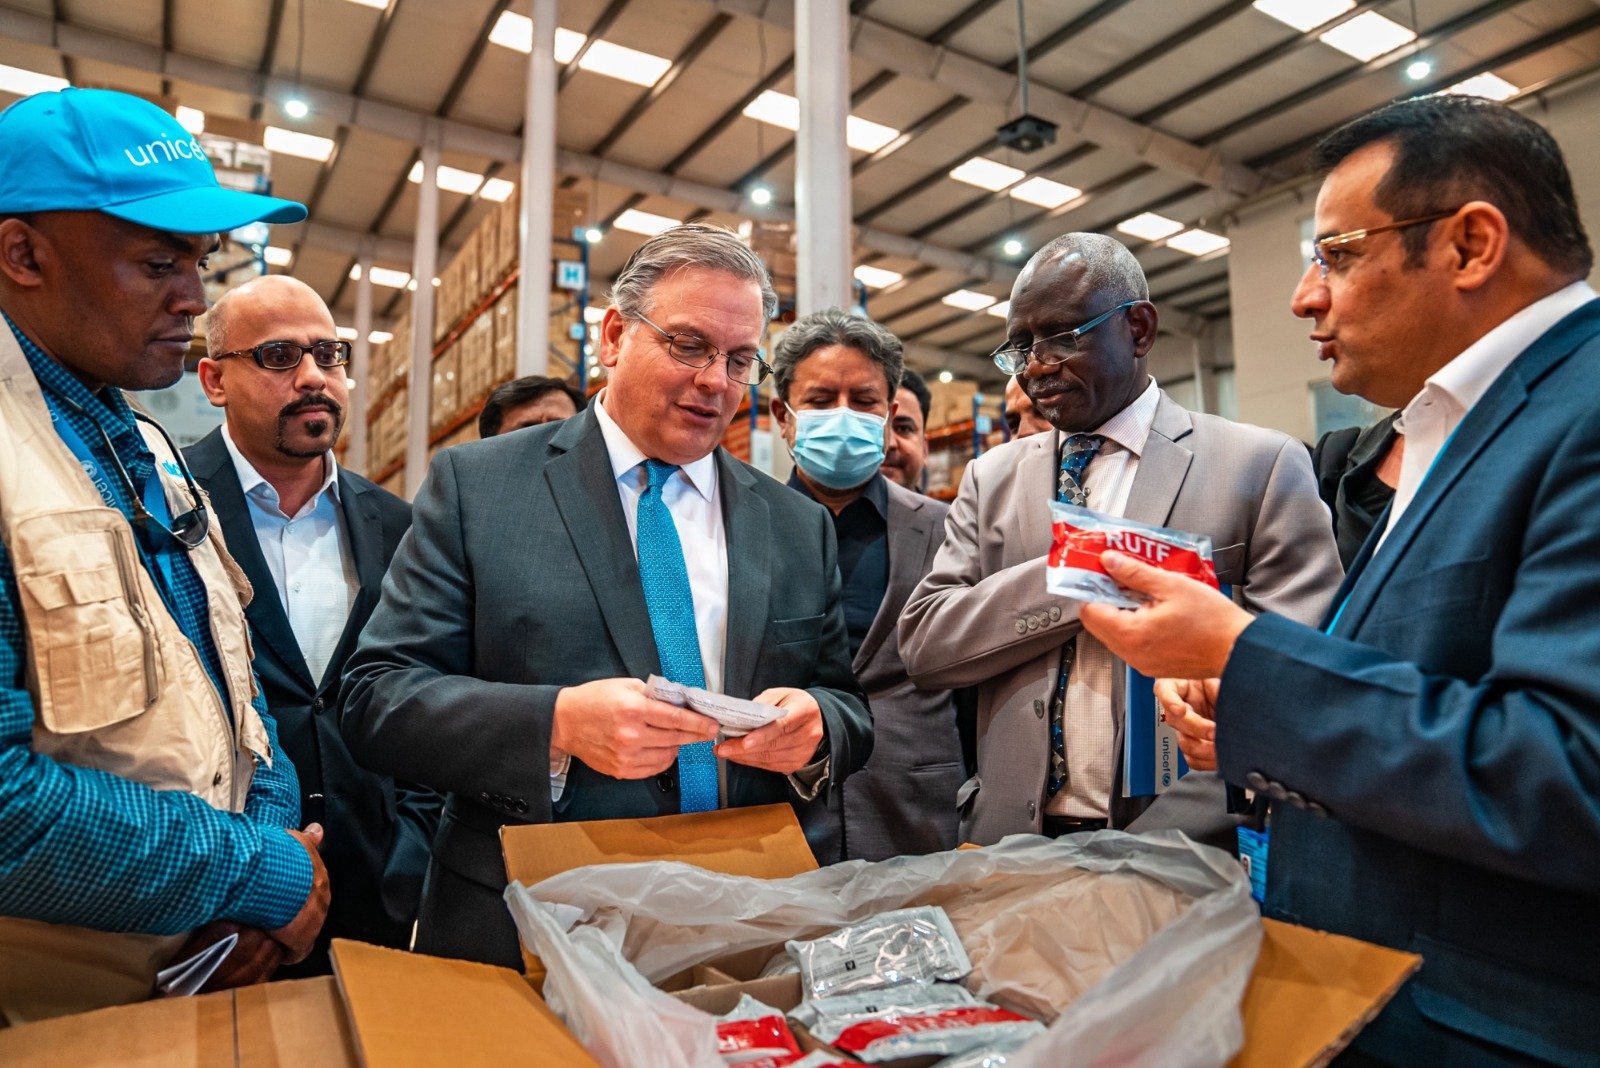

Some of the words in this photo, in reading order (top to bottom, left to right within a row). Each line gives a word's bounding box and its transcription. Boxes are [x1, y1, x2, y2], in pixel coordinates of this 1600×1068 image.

[124, 132, 207, 167] unice
[564, 266, 579, 282] H
[1105, 530, 1172, 562] RUTF
[1162, 736, 1171, 772] unicef
